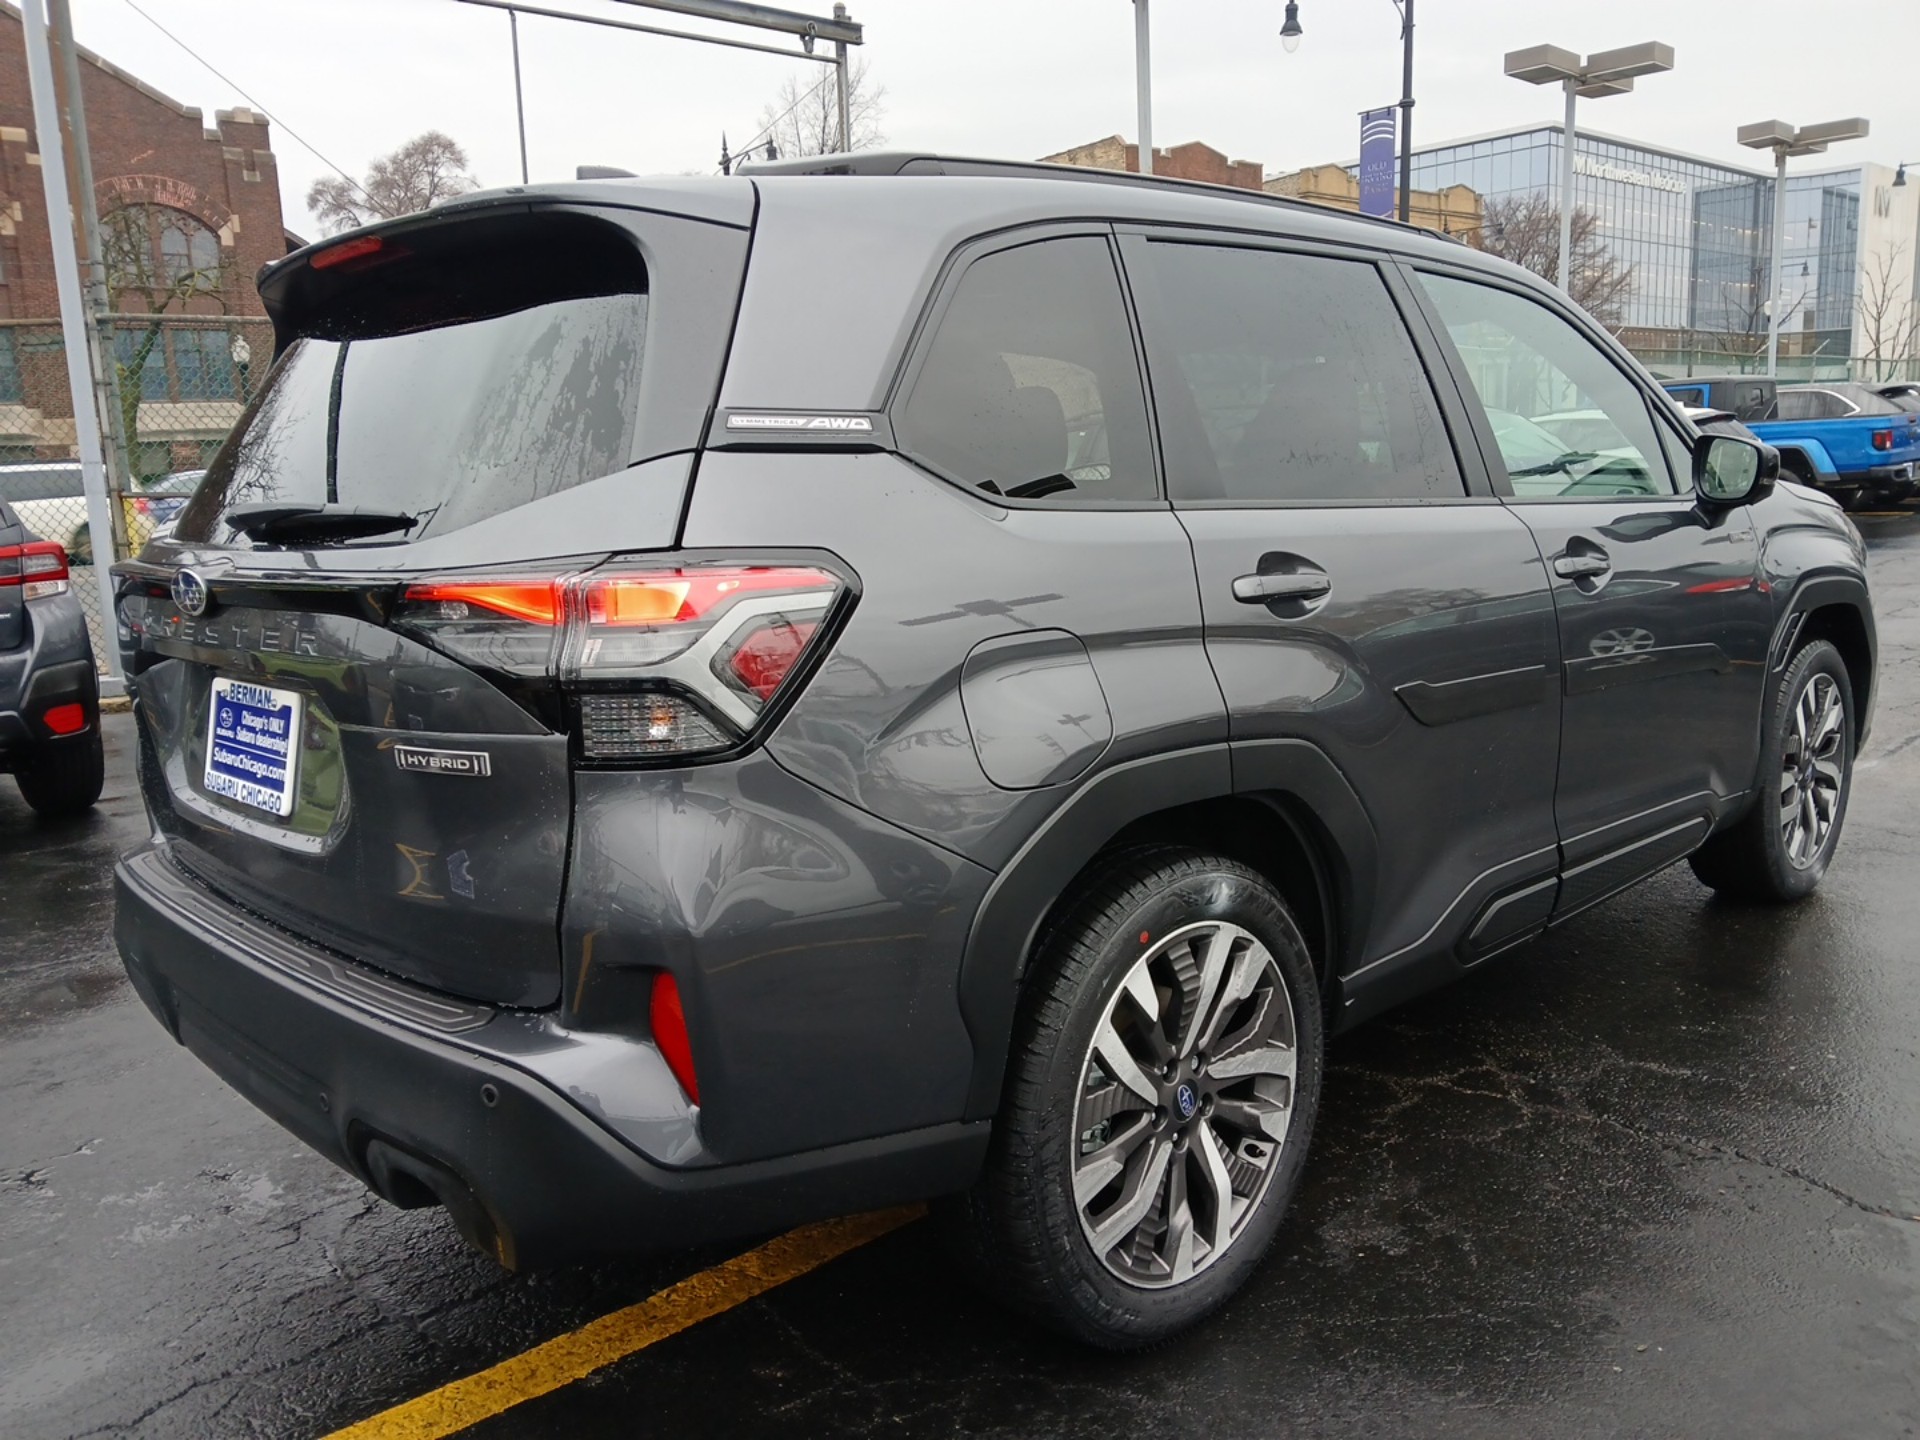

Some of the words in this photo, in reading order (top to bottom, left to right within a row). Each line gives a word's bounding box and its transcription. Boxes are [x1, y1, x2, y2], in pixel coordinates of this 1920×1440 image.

[806, 417, 871, 430] AWD
[229, 683, 273, 709] BERMAN
[213, 747, 287, 781] SubaruChicago.com
[407, 754, 470, 769] HYBRID
[206, 771, 239, 798] SUBARU
[240, 784, 282, 813] CHICAGO
